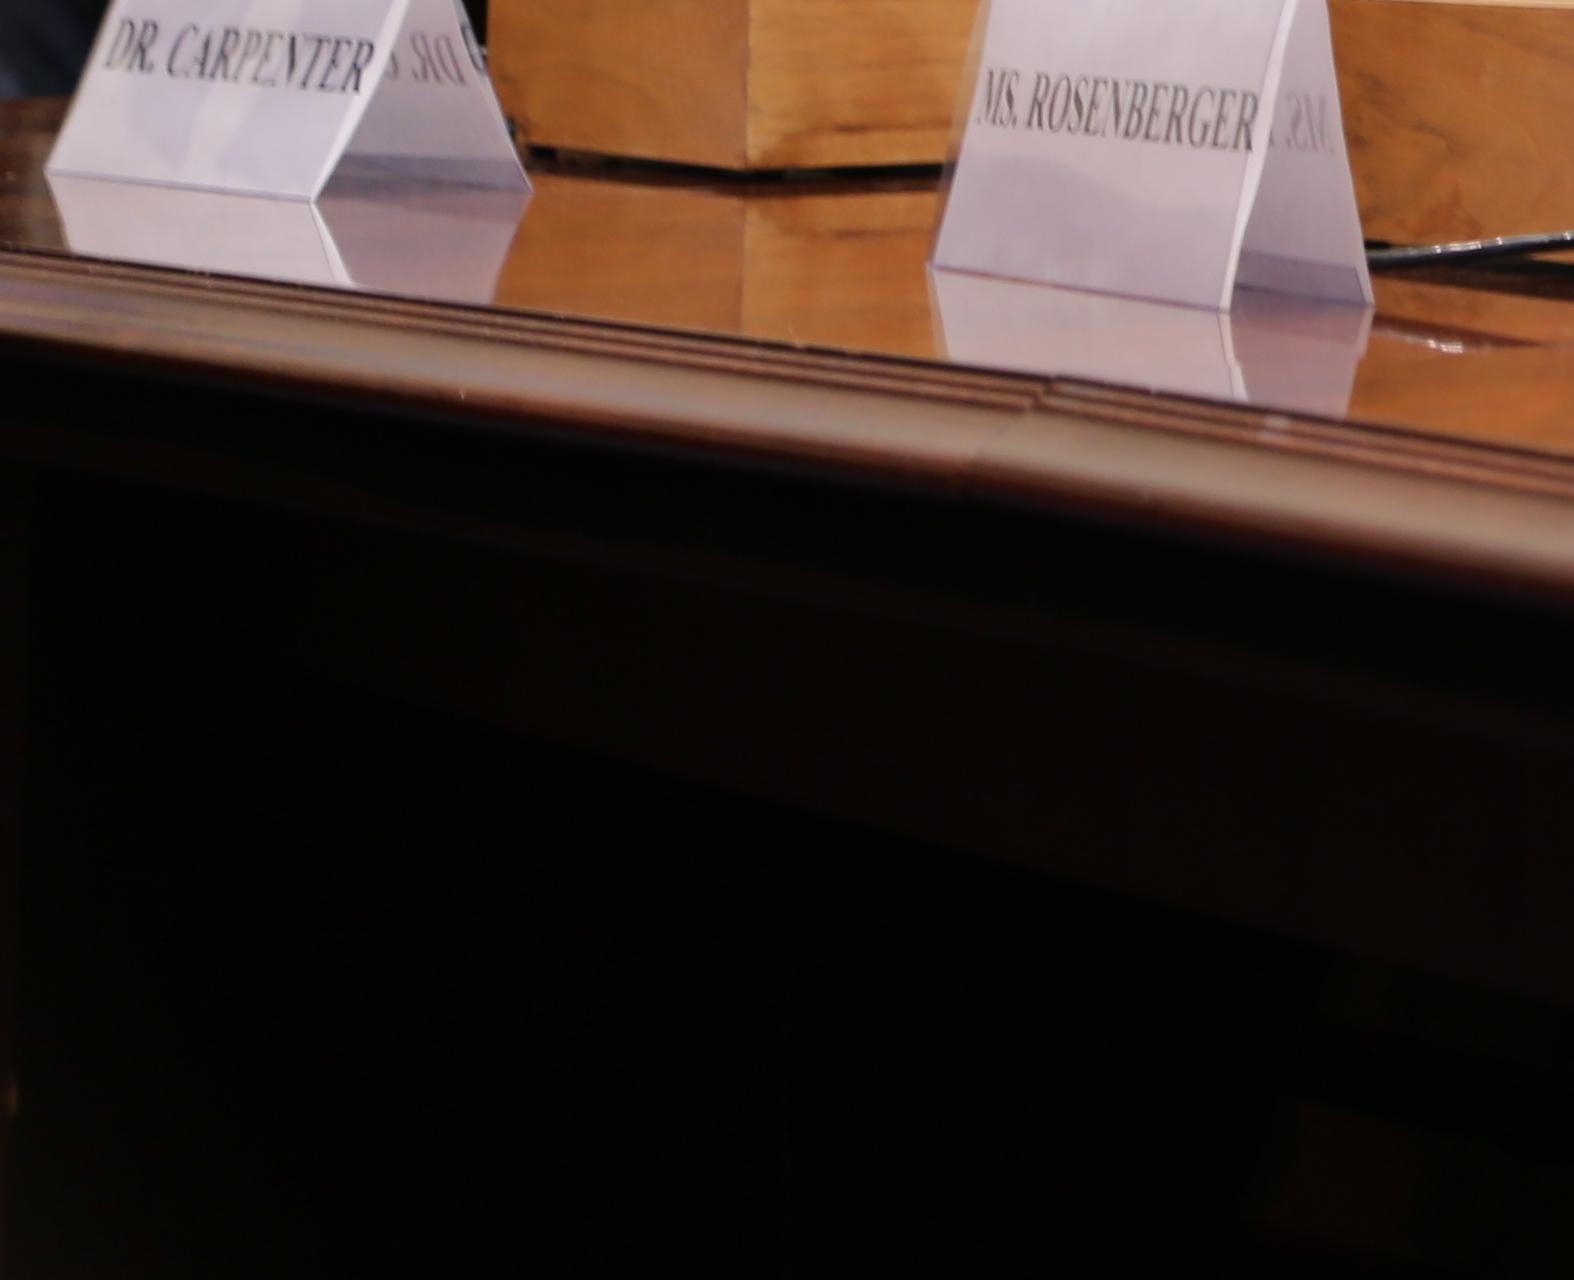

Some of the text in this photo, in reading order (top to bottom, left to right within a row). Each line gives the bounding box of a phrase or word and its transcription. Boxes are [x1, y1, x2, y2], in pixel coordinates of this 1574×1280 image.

[105, 19, 374, 93] DR. CARPENTER
[977, 68, 1259, 153] MS. ROSENBERGER
